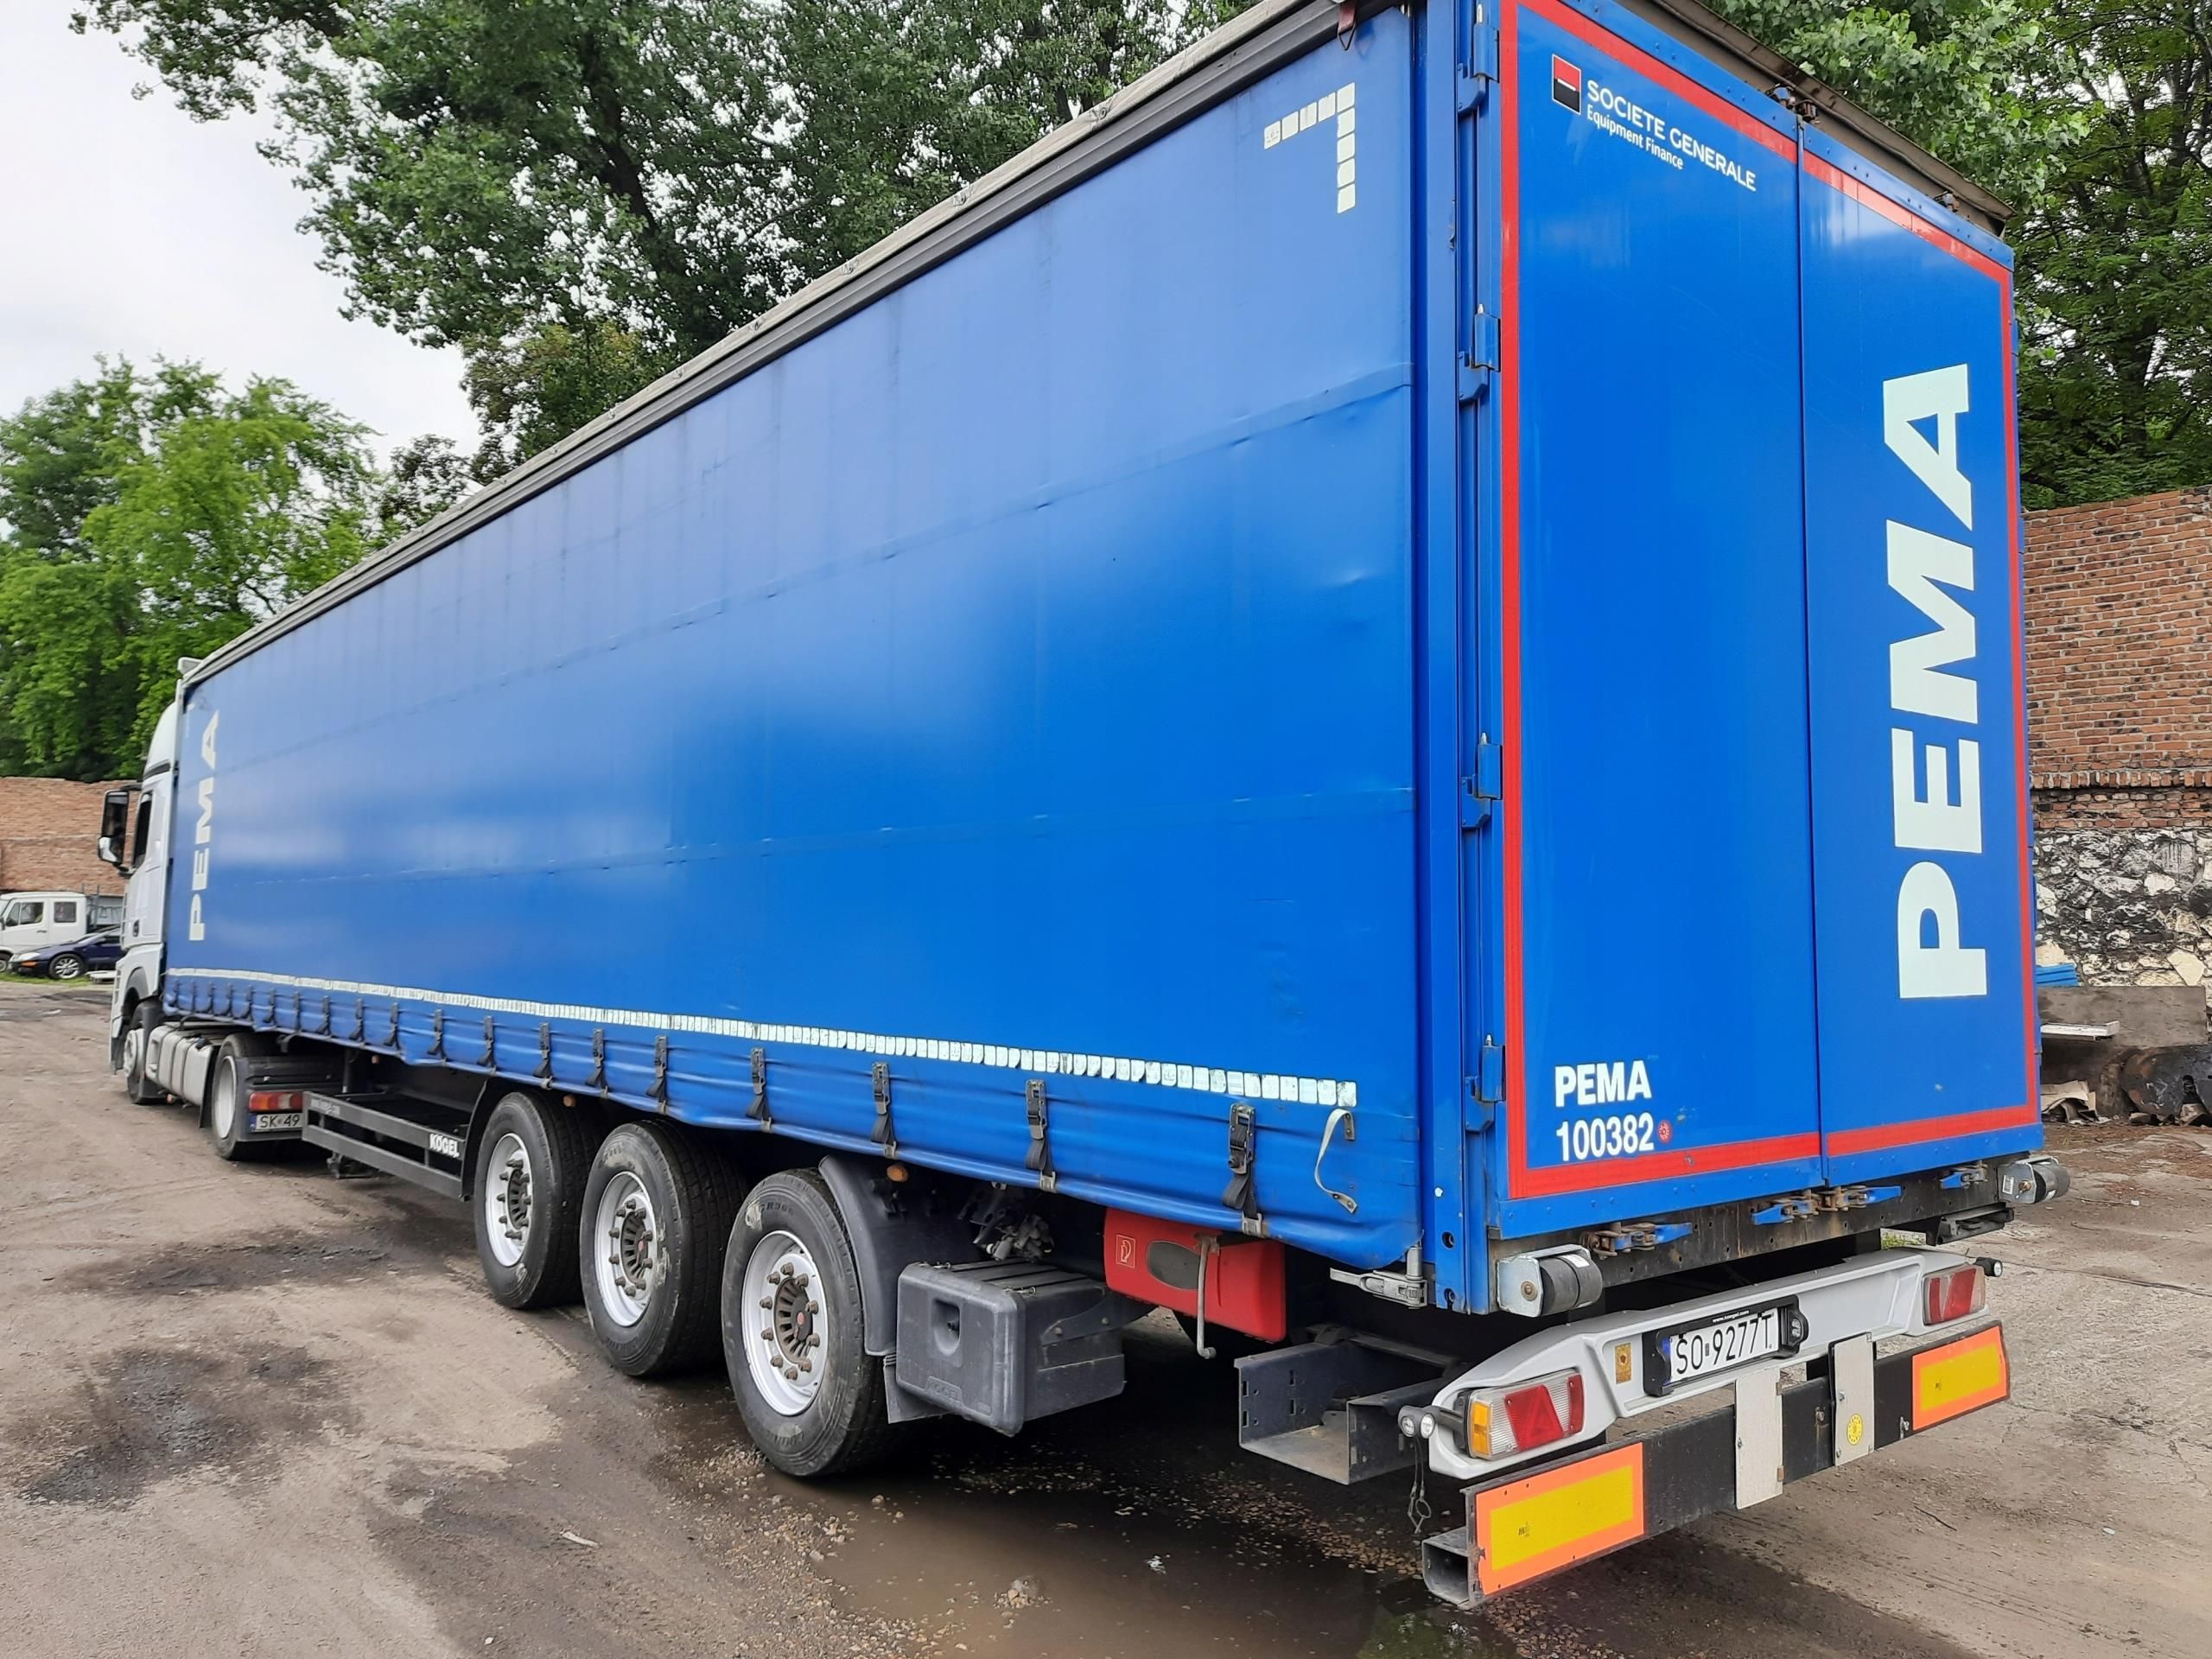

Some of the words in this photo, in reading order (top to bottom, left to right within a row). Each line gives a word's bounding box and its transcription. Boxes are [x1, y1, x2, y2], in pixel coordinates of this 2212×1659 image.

[1586, 79, 1666, 141] SOCIETE
[1669, 127, 1757, 192] GENERALE
[1586, 103, 1643, 149] Equipment
[1645, 137, 1684, 170] Finance
[1882, 363, 1987, 999] PEMA
[188, 709, 219, 941] PEMA
[1554, 1059, 1652, 1108] PEMA
[260, 1115, 276, 1128] SK
[1555, 1111, 1655, 1162] 100382
[1675, 1334, 1704, 1375] SO
[1713, 1312, 1775, 1365] 9277T
